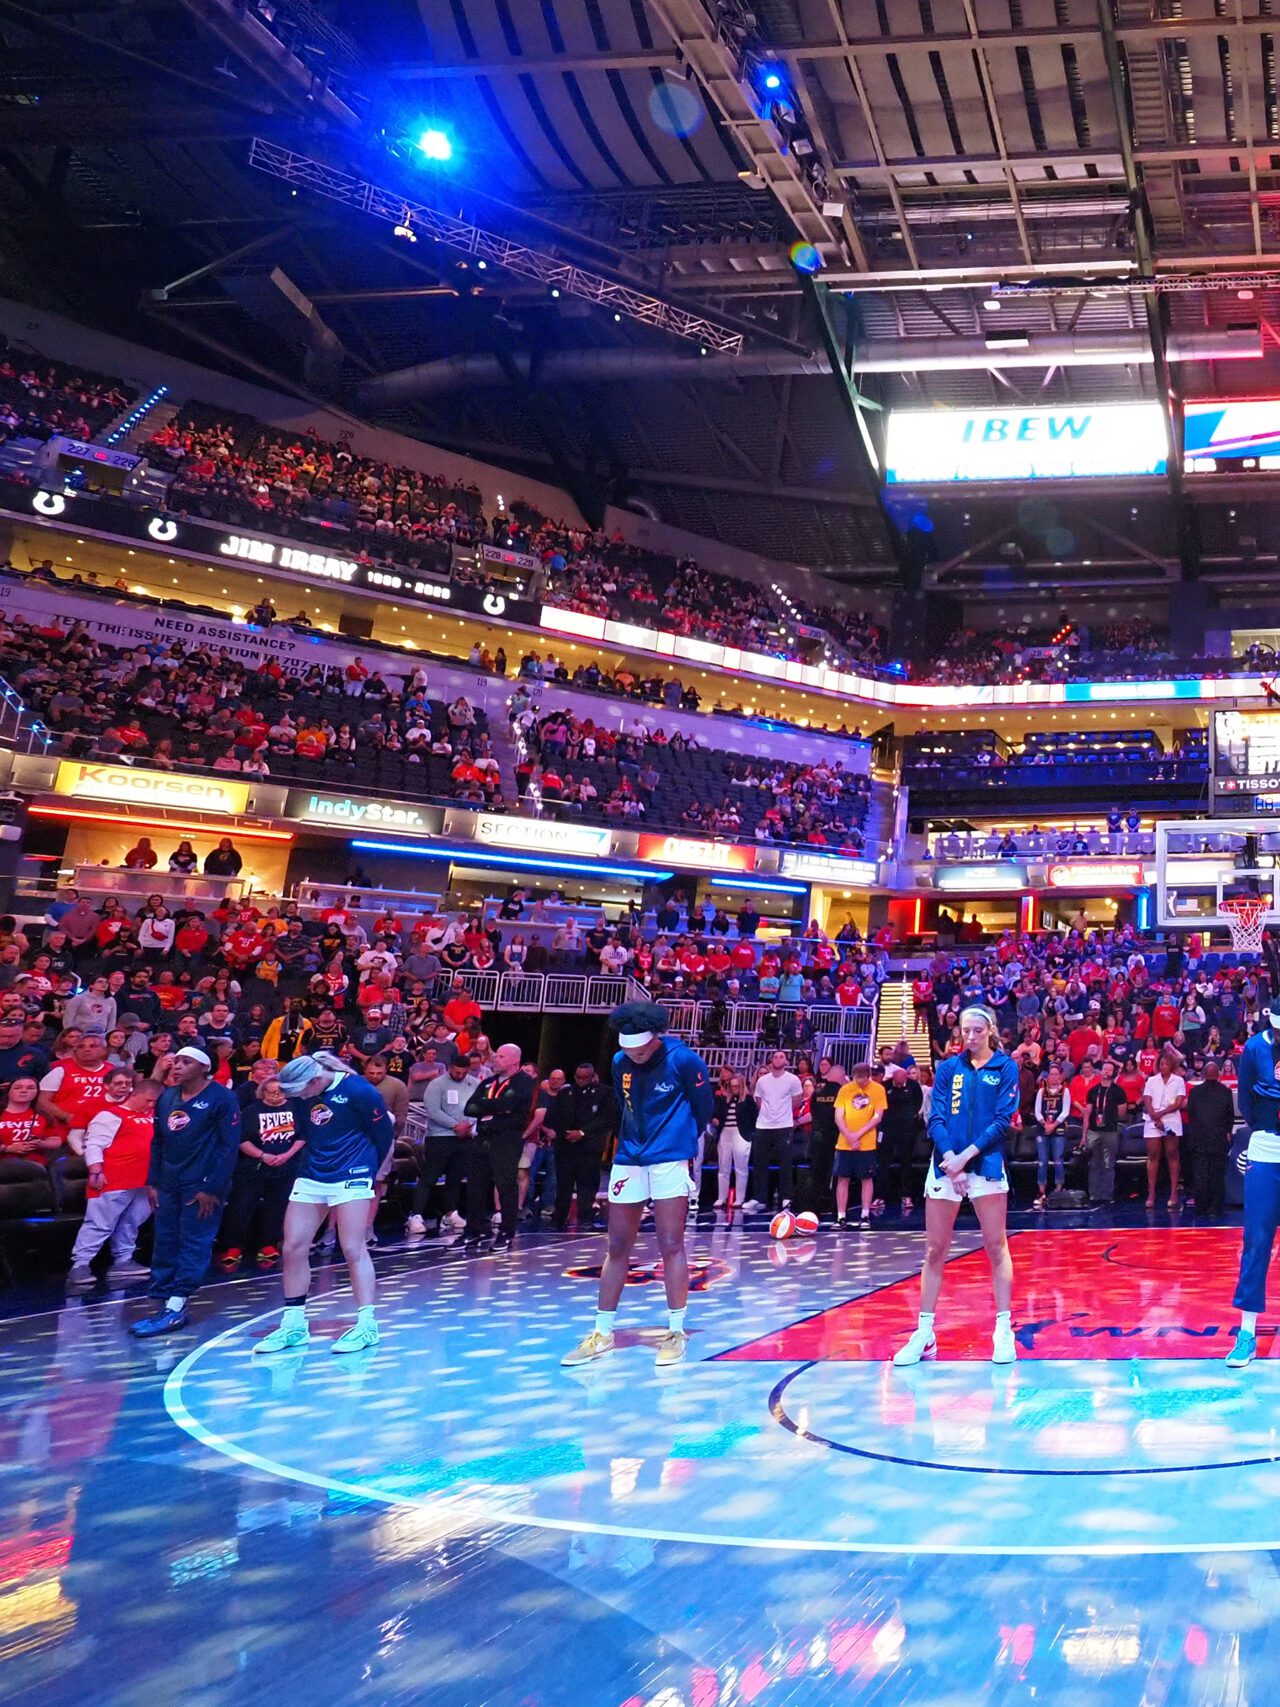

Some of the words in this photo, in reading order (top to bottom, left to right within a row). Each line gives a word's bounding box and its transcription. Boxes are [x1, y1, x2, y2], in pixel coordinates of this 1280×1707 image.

[961, 415, 1092, 443] IBEW
[67, 443, 90, 456] 227
[220, 535, 276, 565] JIM
[279, 548, 358, 582] IRSAY
[154, 616, 194, 634] NEED
[199, 624, 296, 652] ASSISTANCE?
[78, 765, 225, 799] Koorsen
[480, 820, 569, 842] SECTION
[390, 1057, 403, 1073] 22
[74, 1076, 103, 1084] FEVE
[84, 1085, 103, 1098] 22
[951, 1073, 965, 1115] FEVER
[258, 1111, 295, 1132] FEVER
[12, 1129, 31, 1142] 22
